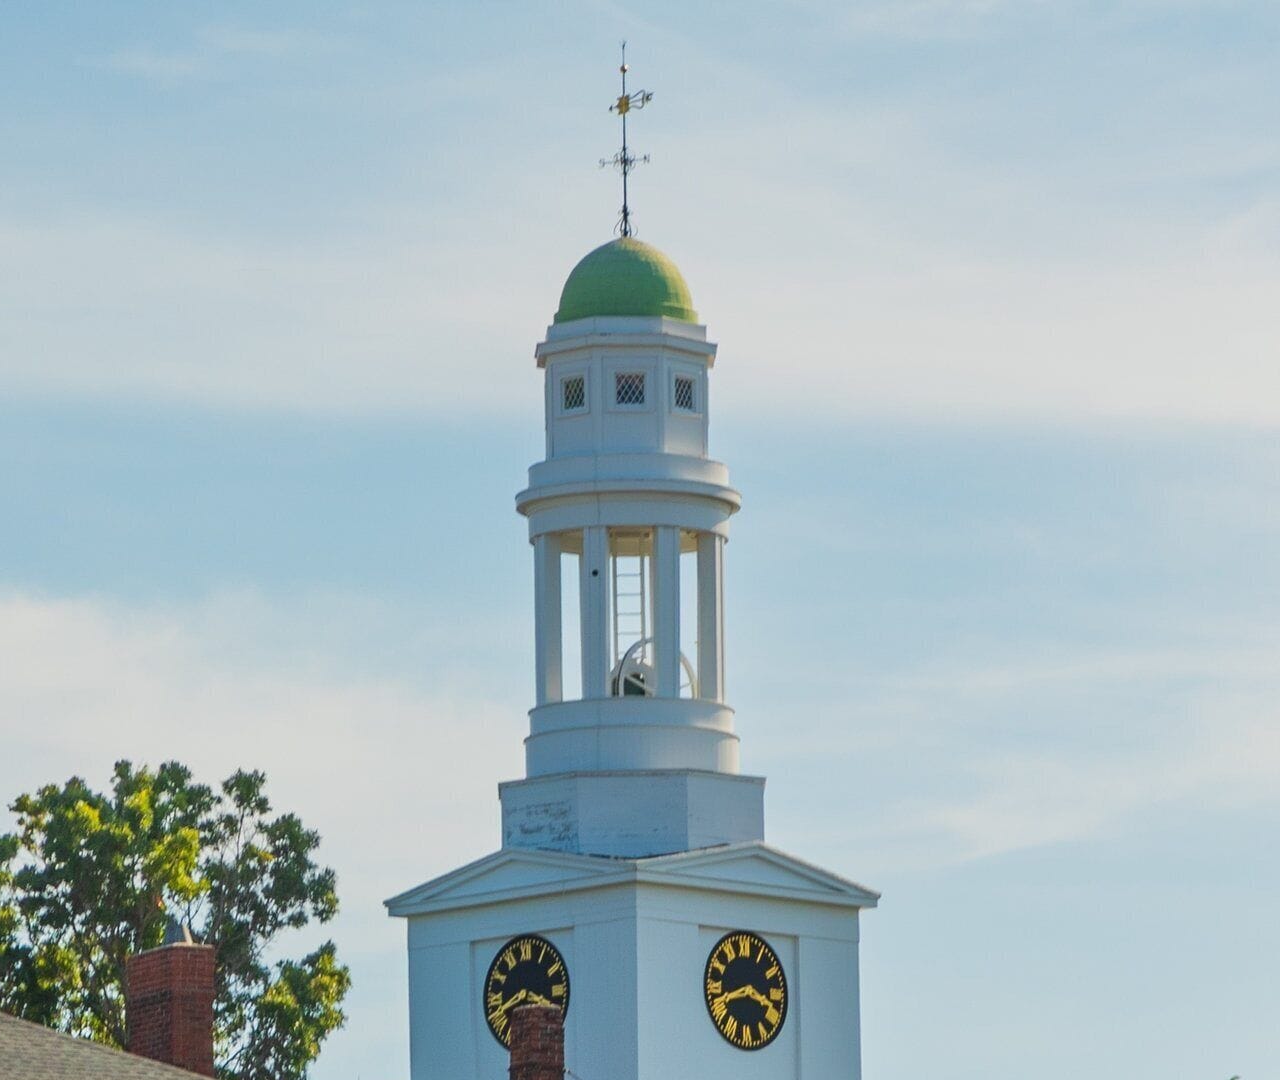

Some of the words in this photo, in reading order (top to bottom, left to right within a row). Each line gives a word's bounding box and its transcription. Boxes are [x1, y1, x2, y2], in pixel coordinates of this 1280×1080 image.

[520, 943, 532, 961] XII
[538, 943, 547, 964] I
[723, 942, 736, 964] XI
[739, 938, 750, 957] XII
[756, 945, 765, 963] I
[504, 949, 517, 971] XI
[547, 961, 561, 977] II
[765, 966, 779, 979] II
